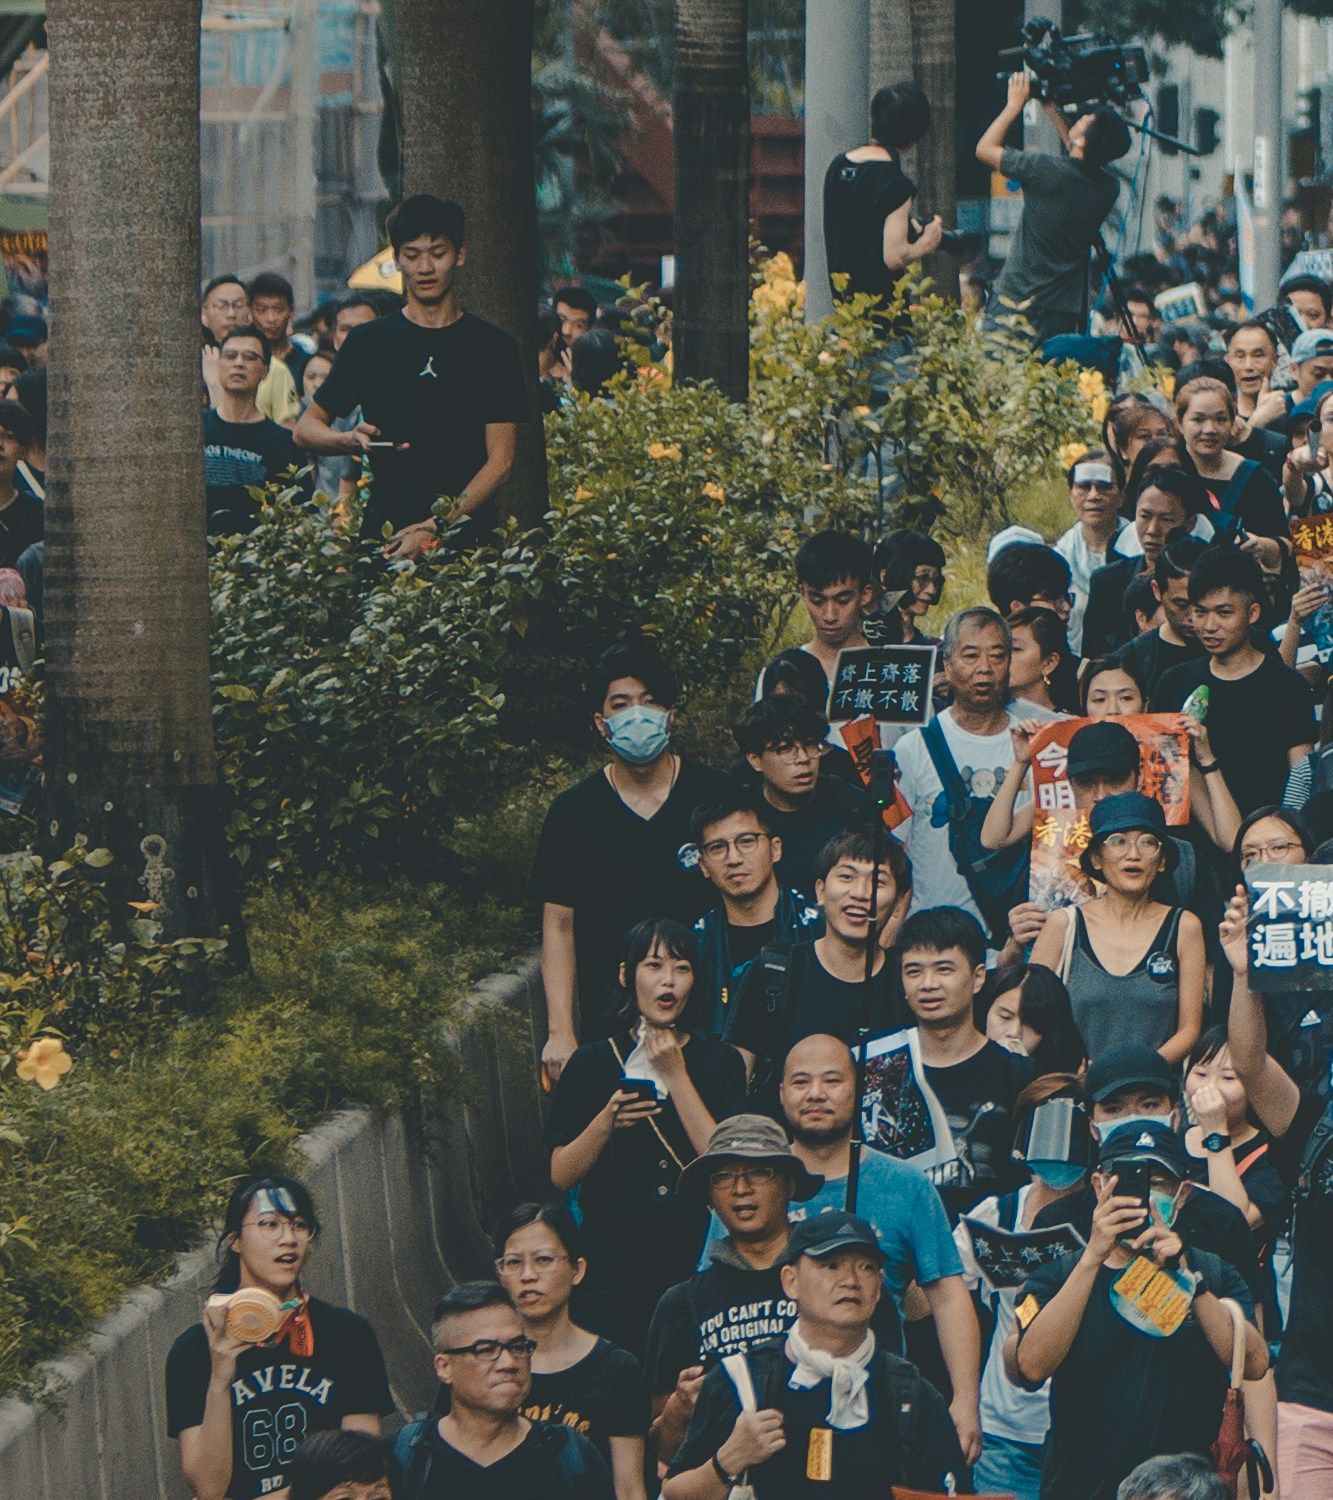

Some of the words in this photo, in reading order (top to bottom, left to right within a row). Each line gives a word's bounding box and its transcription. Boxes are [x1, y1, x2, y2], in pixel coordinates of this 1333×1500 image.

[841, 661, 922, 685] 齊上齊落
[836, 687, 919, 712] 不撤不散
[700, 1312, 725, 1338] YOU
[728, 1299, 775, 1324] CAN'T
[777, 1299, 801, 1319] CO
[231, 1363, 334, 1406] AVELA
[243, 1402, 307, 1471] 68
